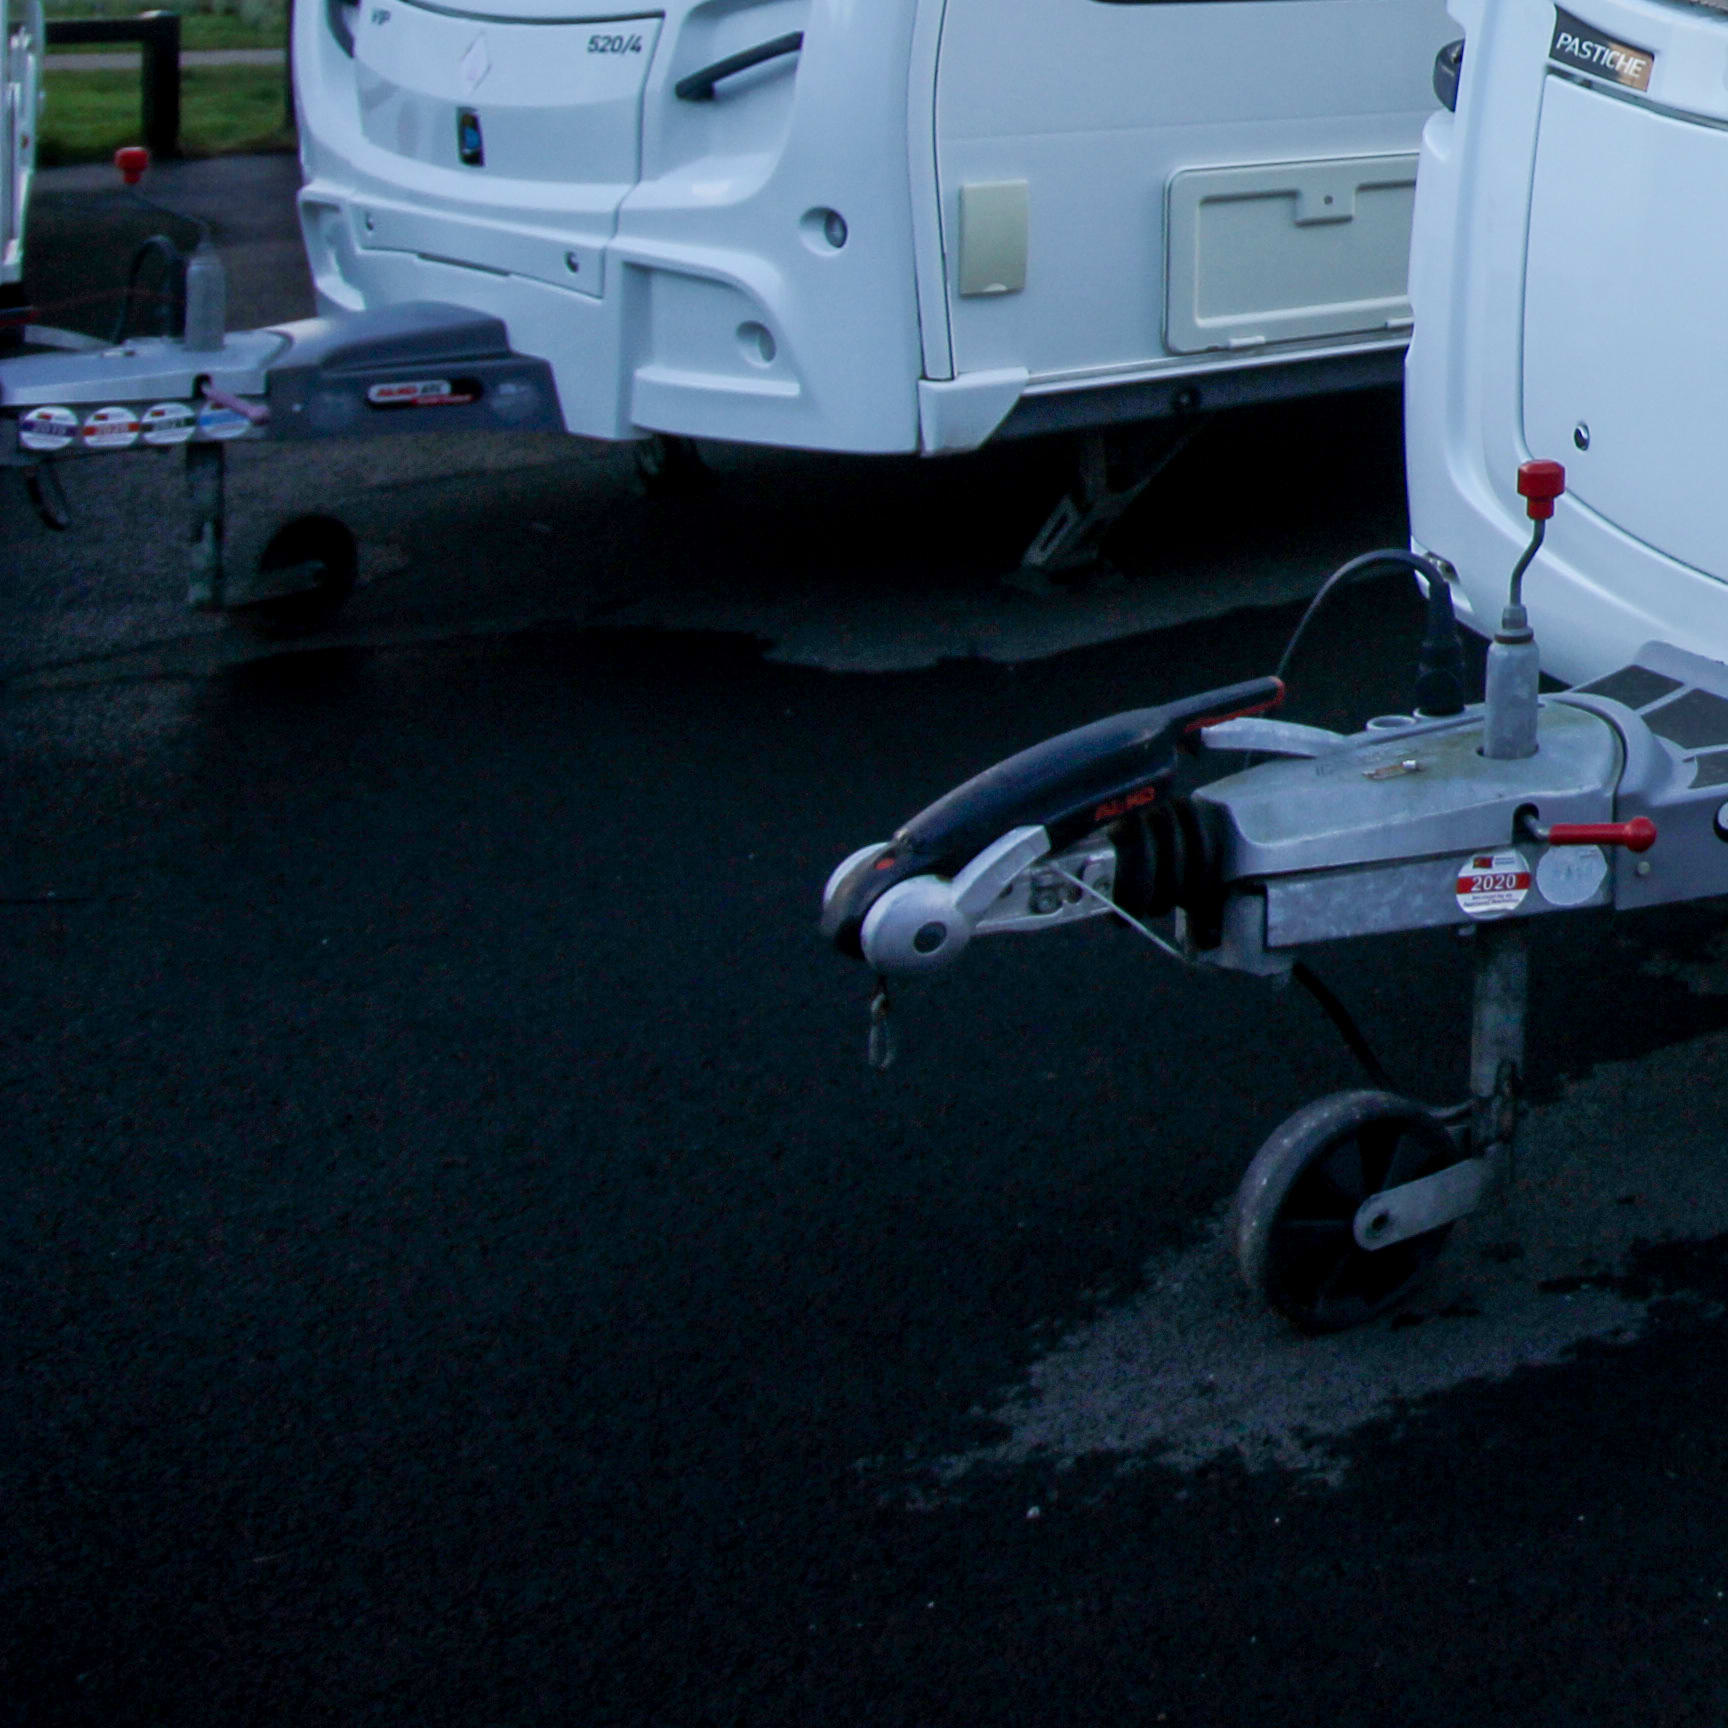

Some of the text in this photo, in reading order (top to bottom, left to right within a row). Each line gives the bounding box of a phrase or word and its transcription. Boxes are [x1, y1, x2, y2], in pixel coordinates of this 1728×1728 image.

[586, 34, 643, 54] 520/4
[1556, 32, 1647, 78] PASTICHE
[1470, 874, 1517, 892] 2020
